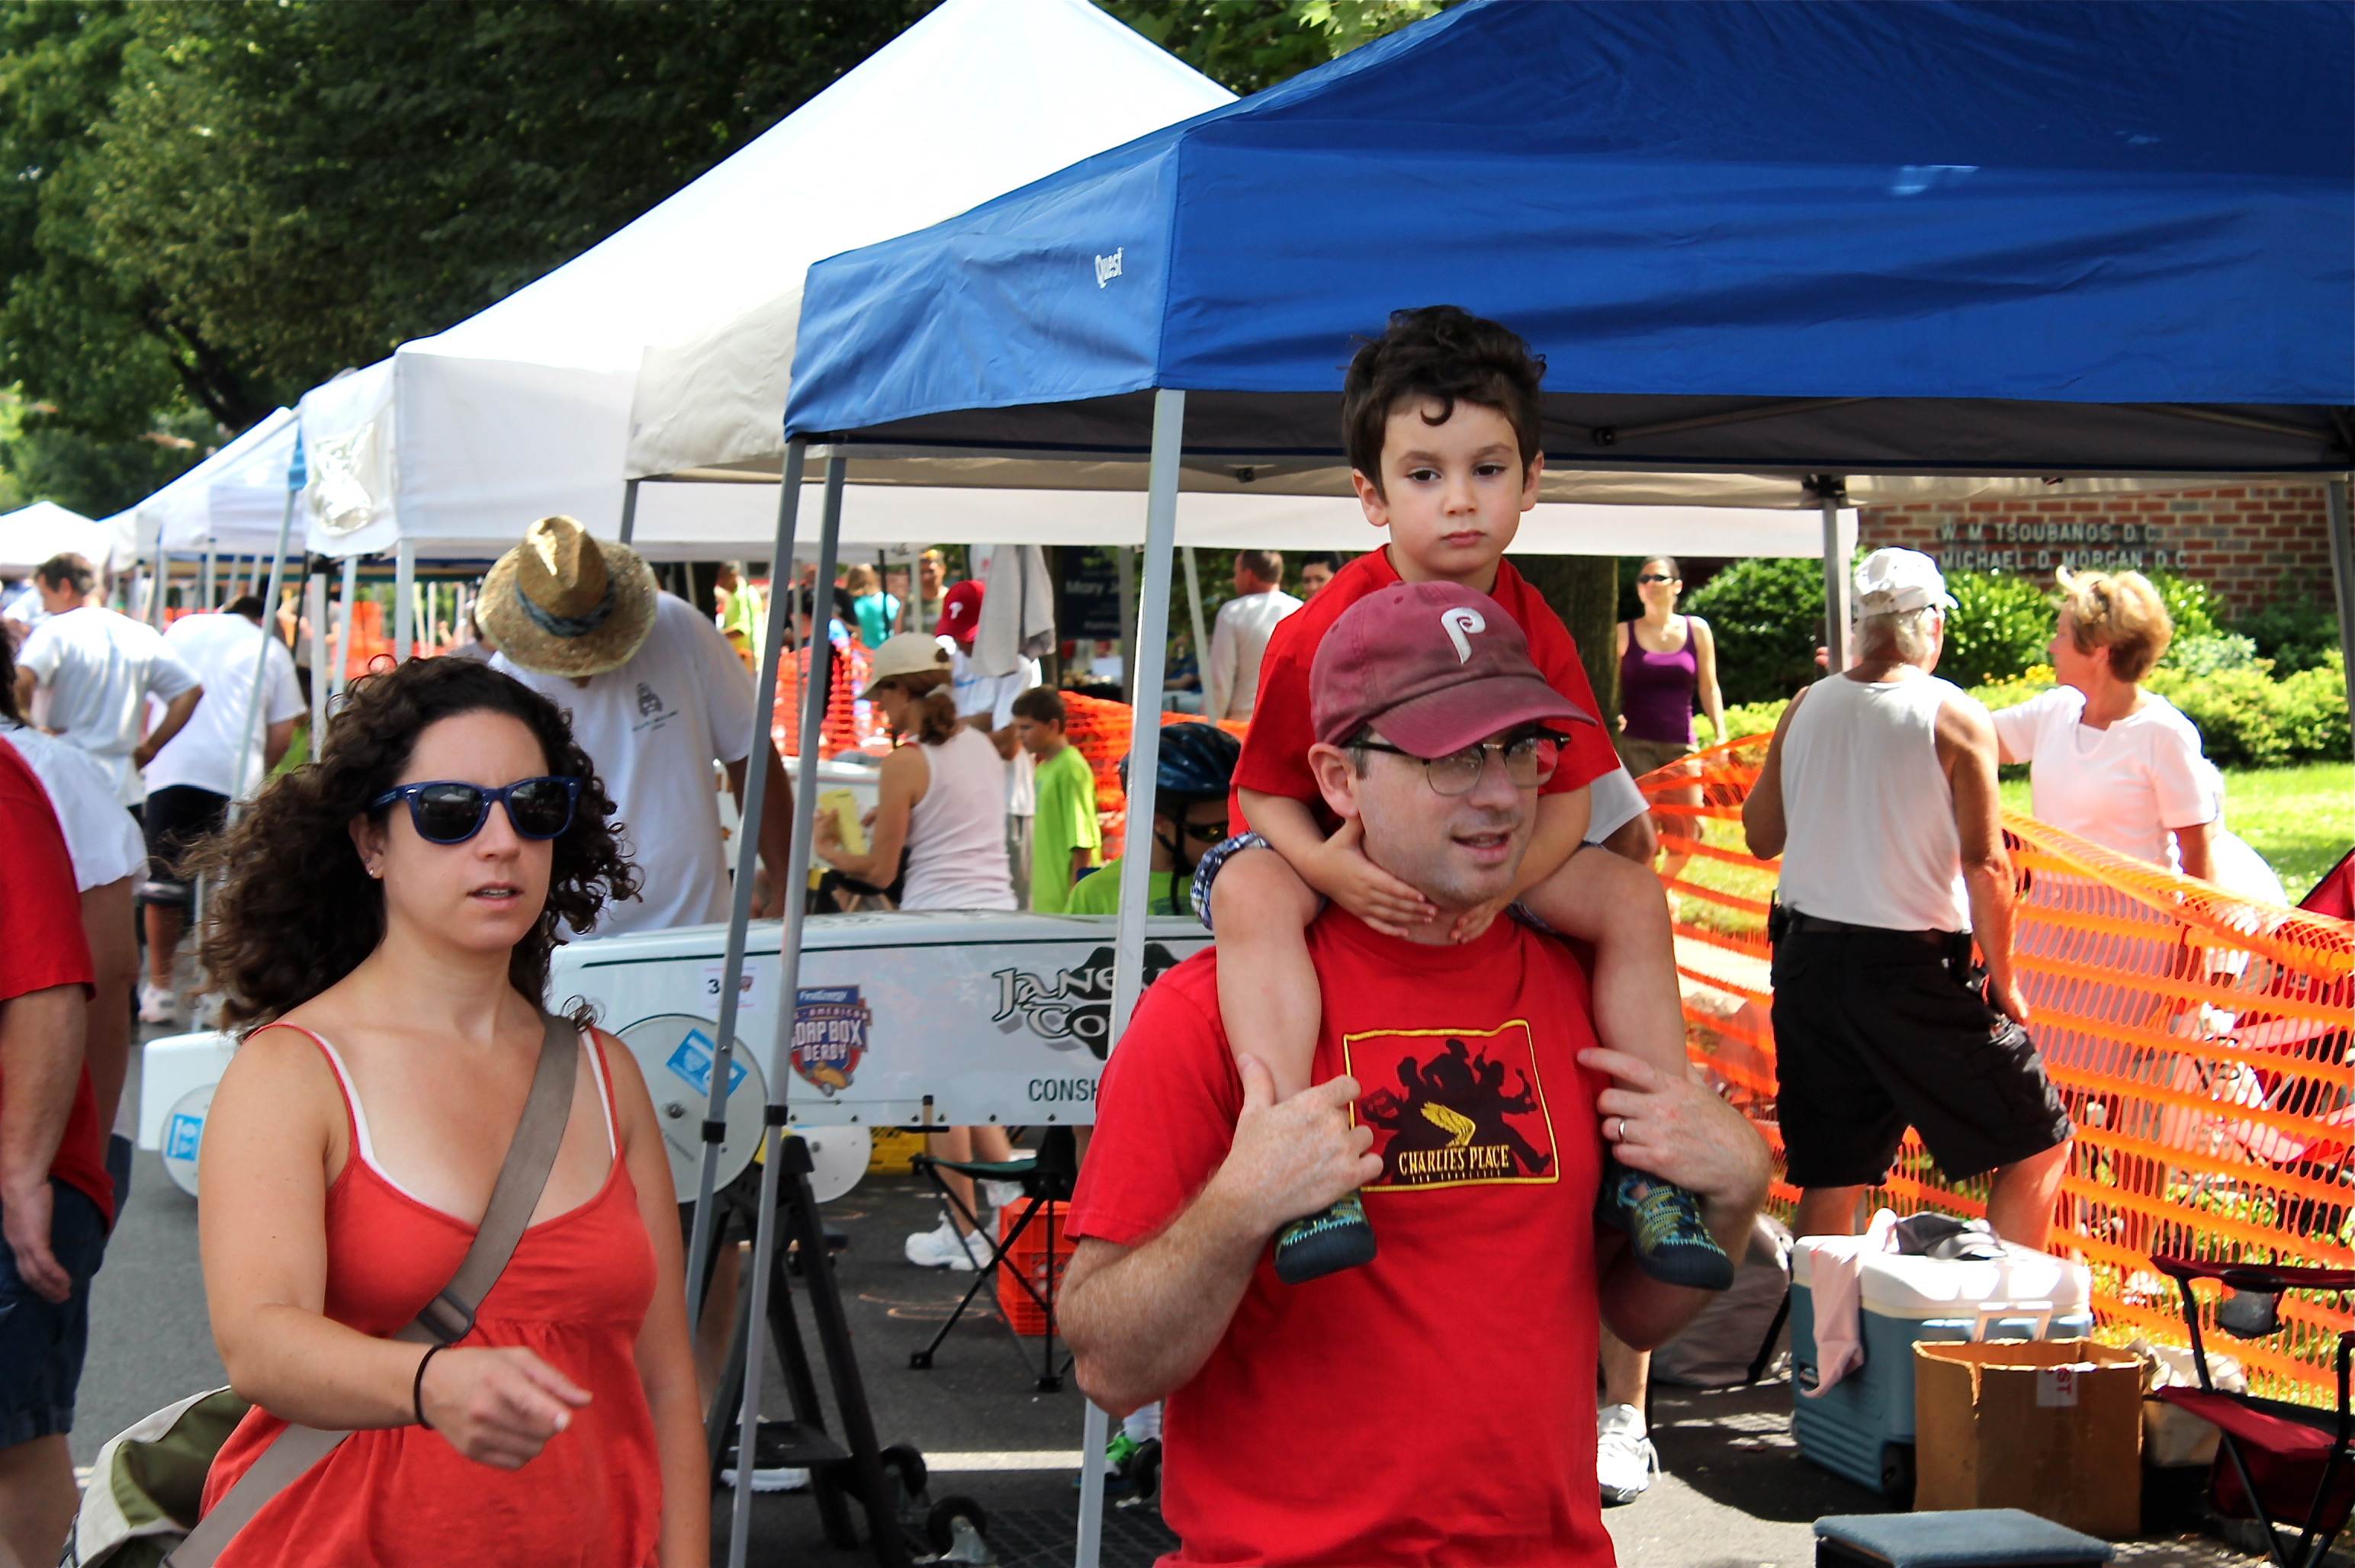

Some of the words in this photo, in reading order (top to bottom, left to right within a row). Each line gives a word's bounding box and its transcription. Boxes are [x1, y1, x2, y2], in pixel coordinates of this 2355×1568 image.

[1094, 247, 1123, 288] Quest
[1995, 523, 2112, 542] TSOUBANOS
[1940, 550, 2026, 570] MICHAEL
[1441, 607, 1486, 665] P
[992, 967, 1117, 1022] JANE
[828, 1019, 863, 1046] BOX
[1022, 1003, 1110, 1039] CO
[803, 1043, 847, 1062] DERBY
[1470, 1144, 1510, 1170] PLACE
